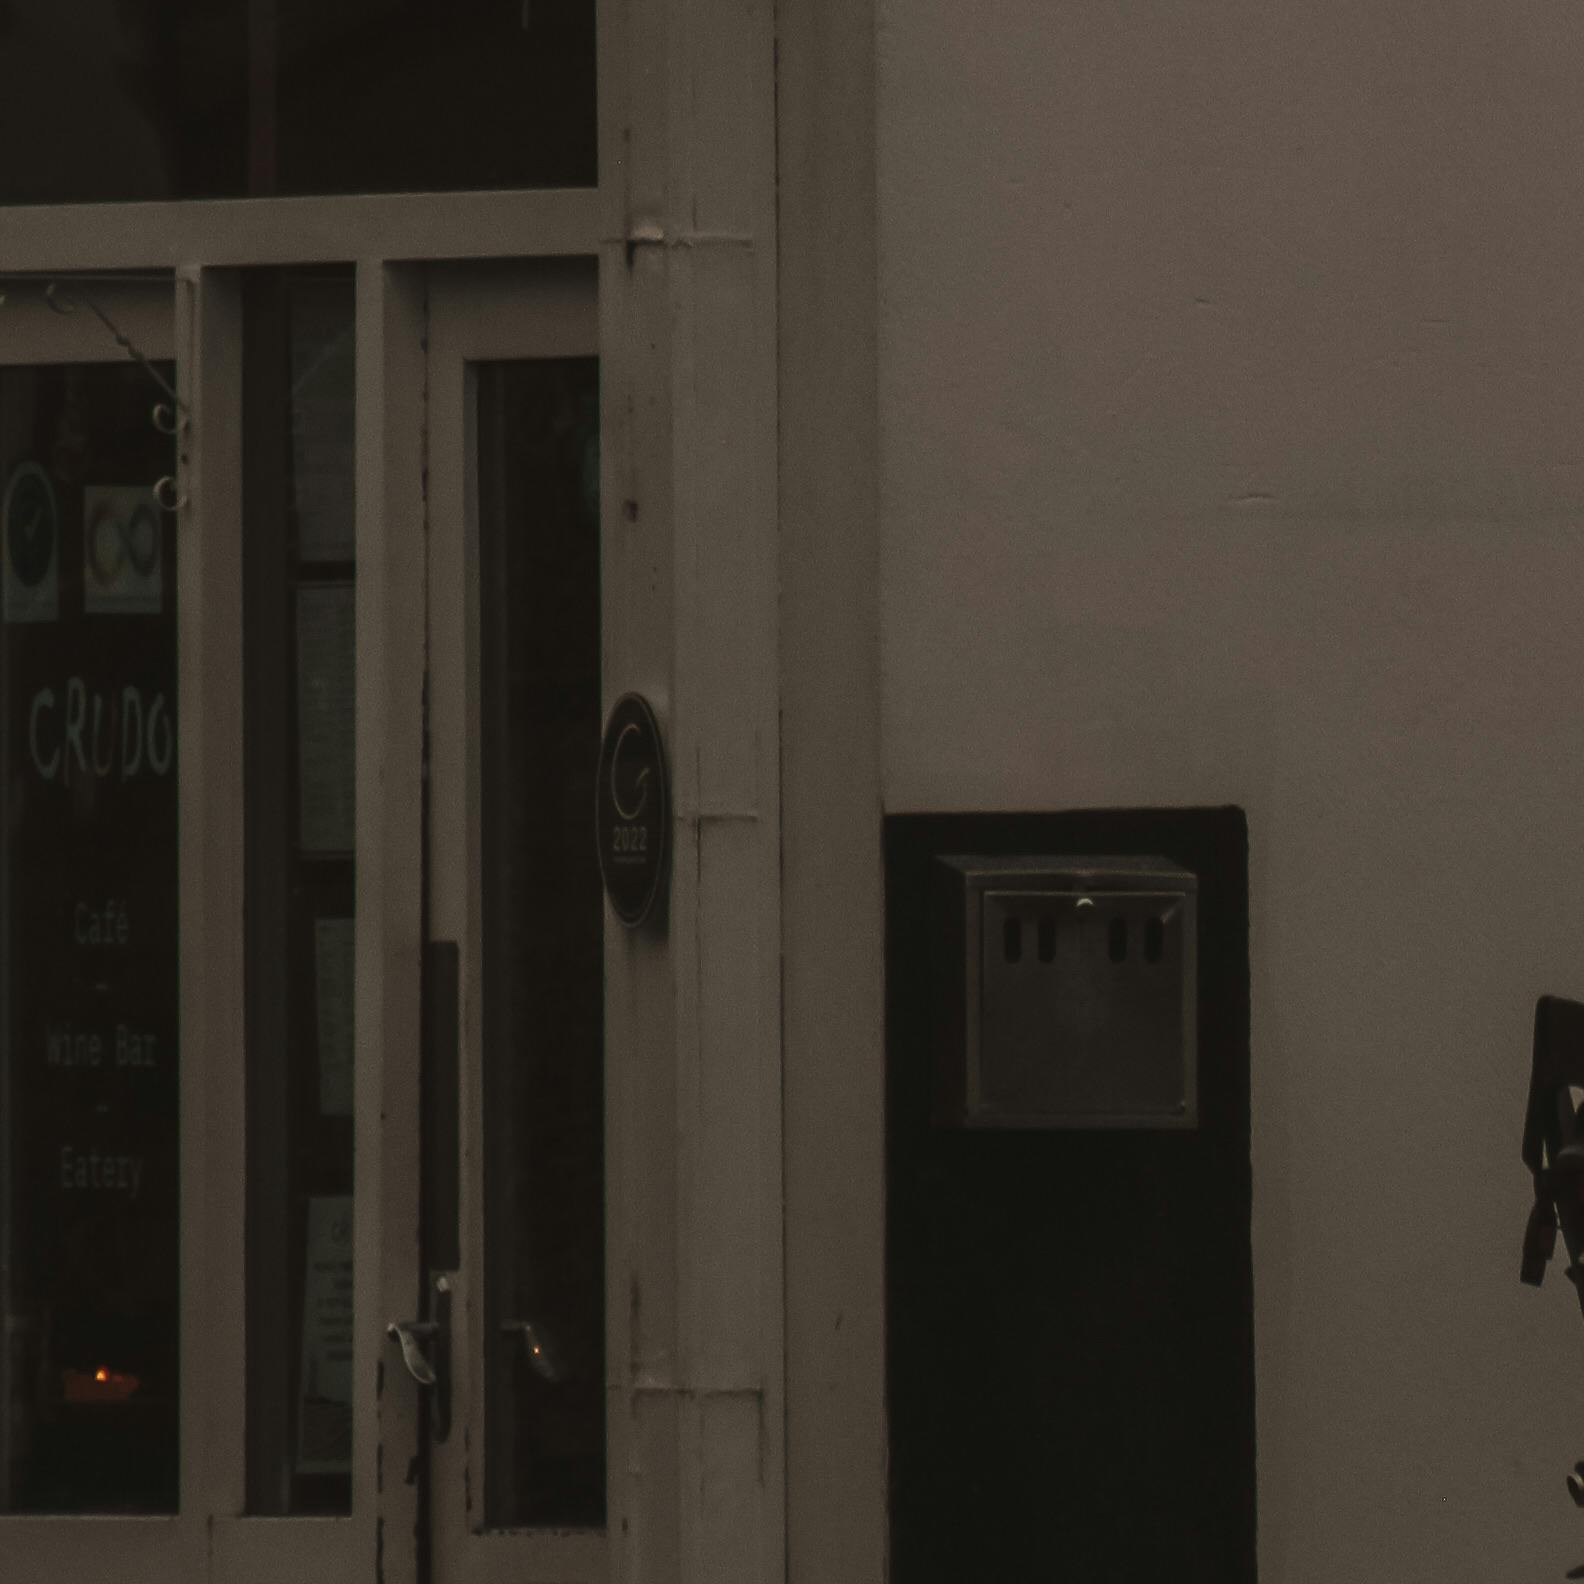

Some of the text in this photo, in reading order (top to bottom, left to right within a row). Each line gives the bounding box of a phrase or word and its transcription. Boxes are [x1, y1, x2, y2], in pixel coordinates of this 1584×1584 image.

[29, 675, 174, 790] CRUDO
[613, 824, 648, 852] 2022
[74, 896, 129, 945] Café
[47, 1022, 161, 1071] Wine Bar
[60, 1144, 144, 1200] Eatery
